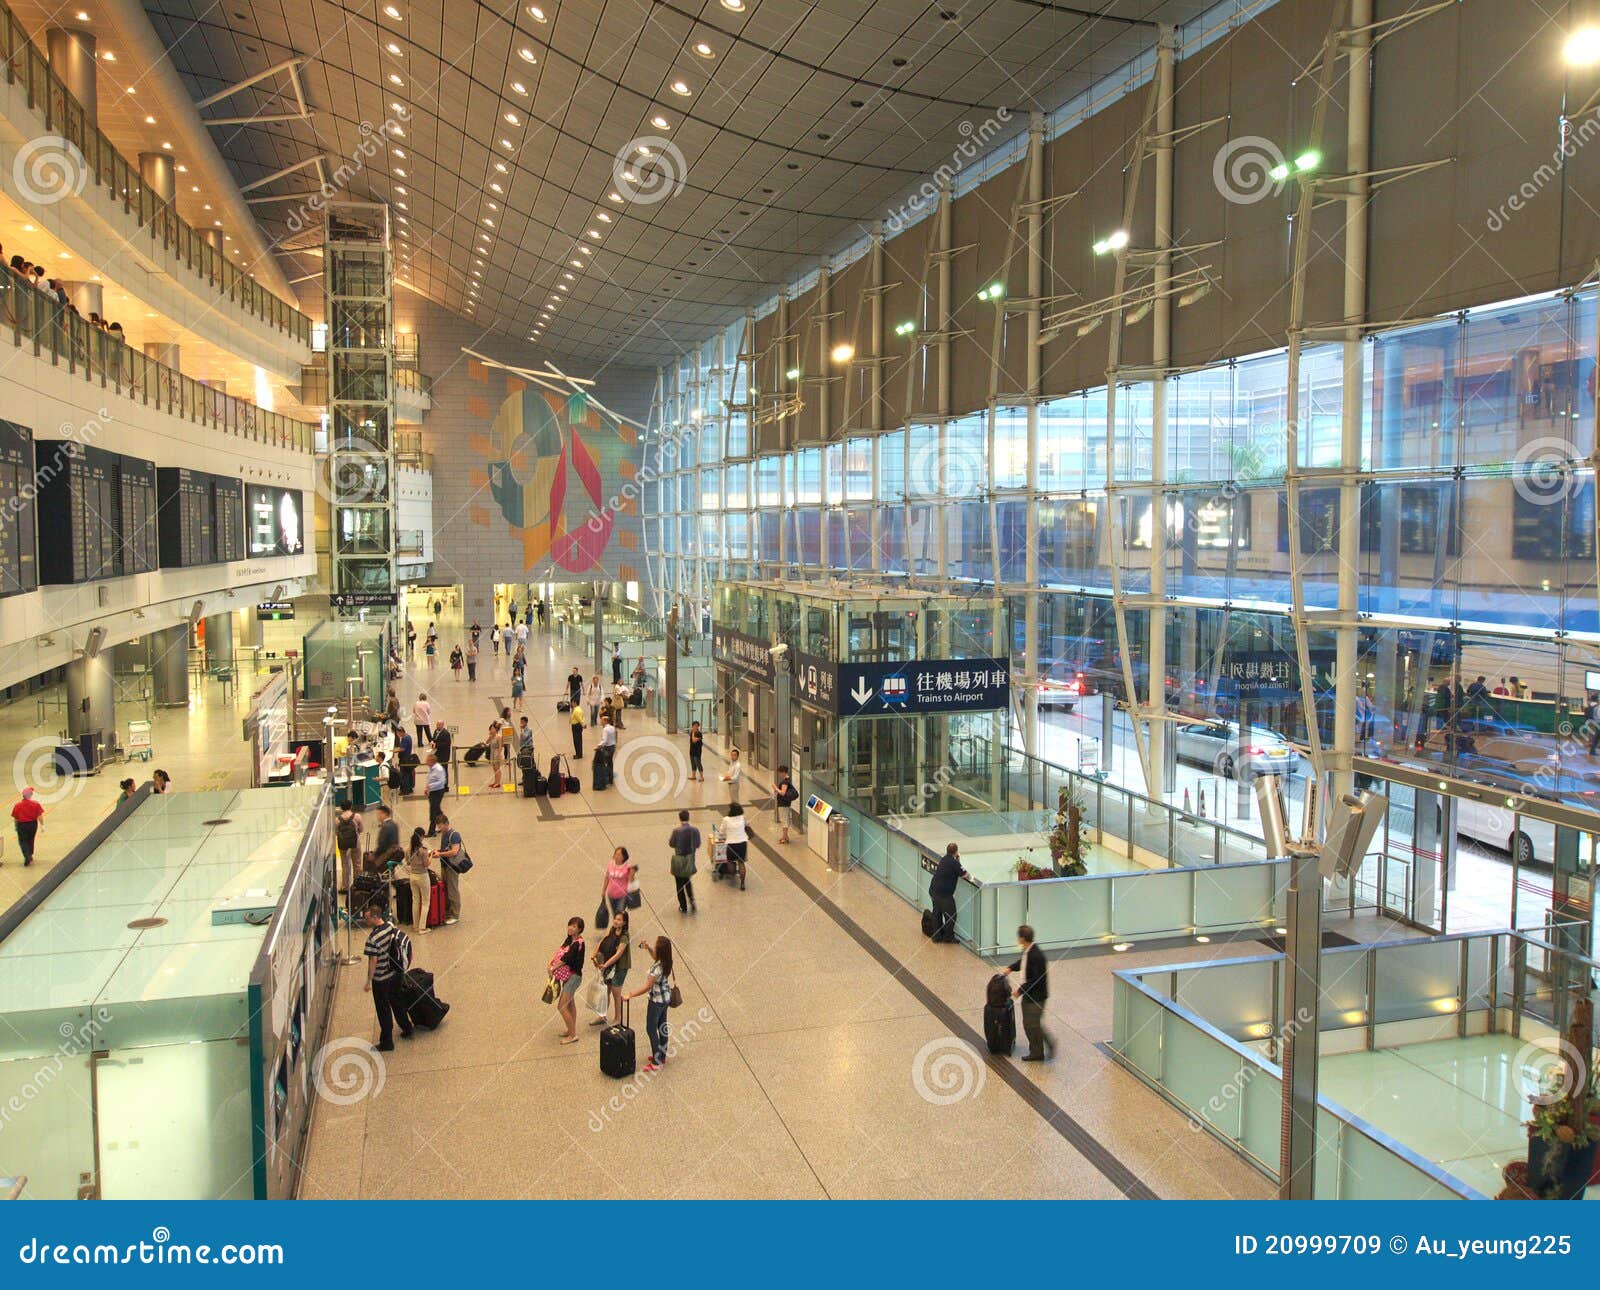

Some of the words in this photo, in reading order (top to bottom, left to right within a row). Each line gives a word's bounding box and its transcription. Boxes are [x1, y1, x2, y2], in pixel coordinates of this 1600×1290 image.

[916, 669, 1007, 692] 往機場列車
[917, 694, 942, 703] Trains
[943, 693, 953, 702] to
[954, 692, 984, 702] Airport
